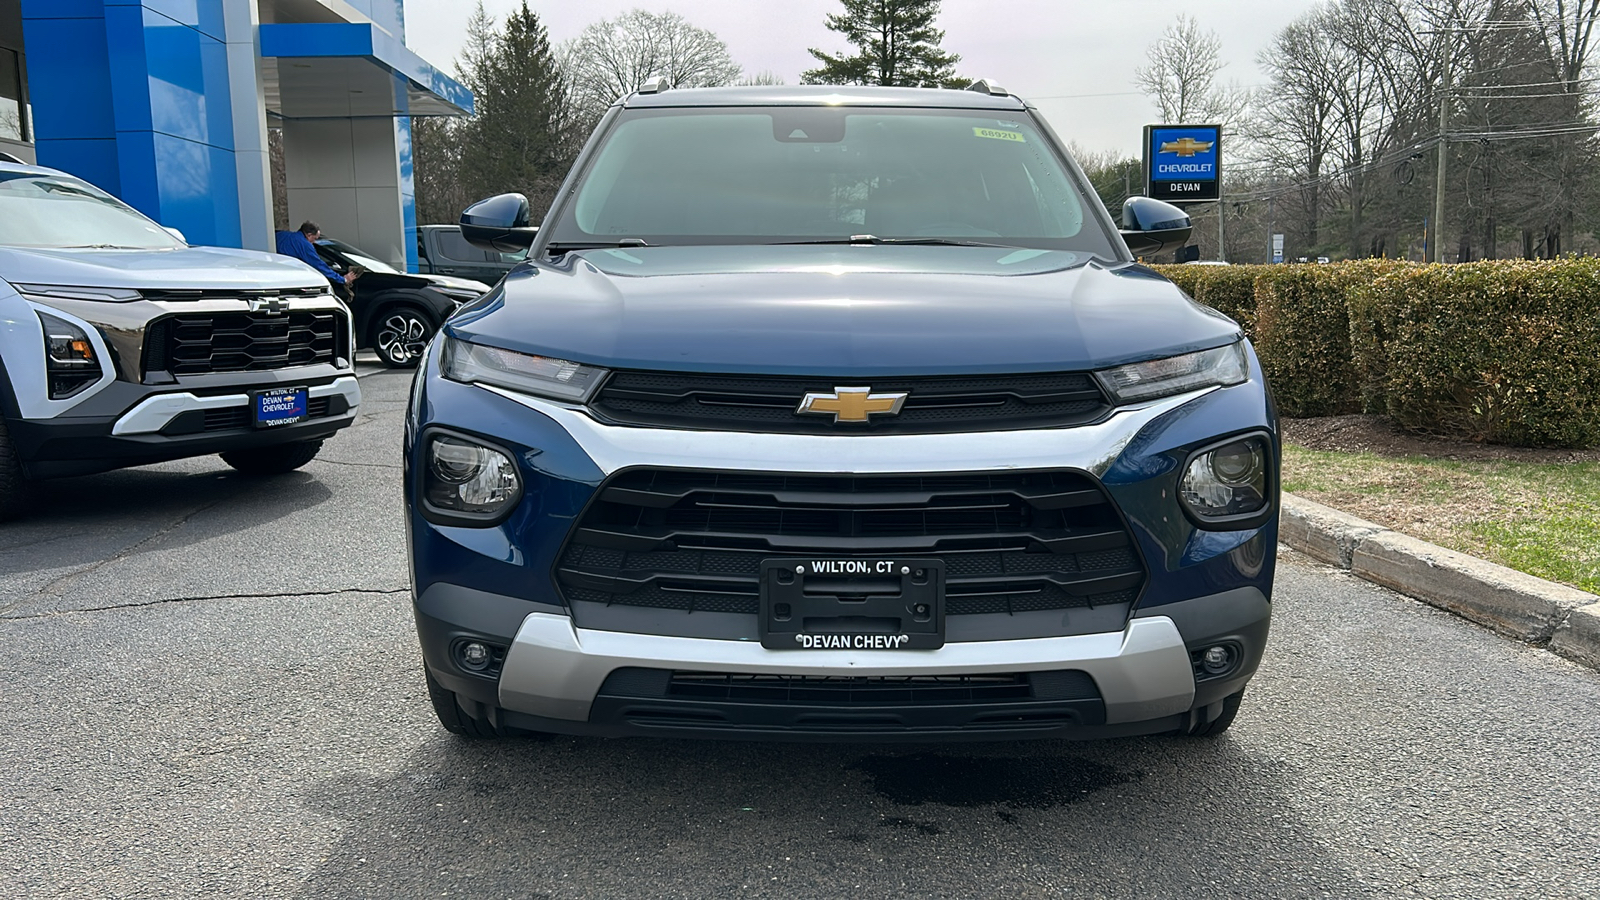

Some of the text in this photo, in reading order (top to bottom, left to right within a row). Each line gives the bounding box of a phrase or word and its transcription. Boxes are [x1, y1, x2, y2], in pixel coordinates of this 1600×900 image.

[981, 130, 1017, 140] 6892U
[1158, 163, 1213, 173] CHEVROLET
[1170, 183, 1200, 192] DEVAN
[262, 396, 282, 405] DEVAN
[262, 402, 294, 412] CHEVROLET
[811, 561, 894, 574] WILTON, CT
[802, 635, 901, 648] DEVAN CHEVY
